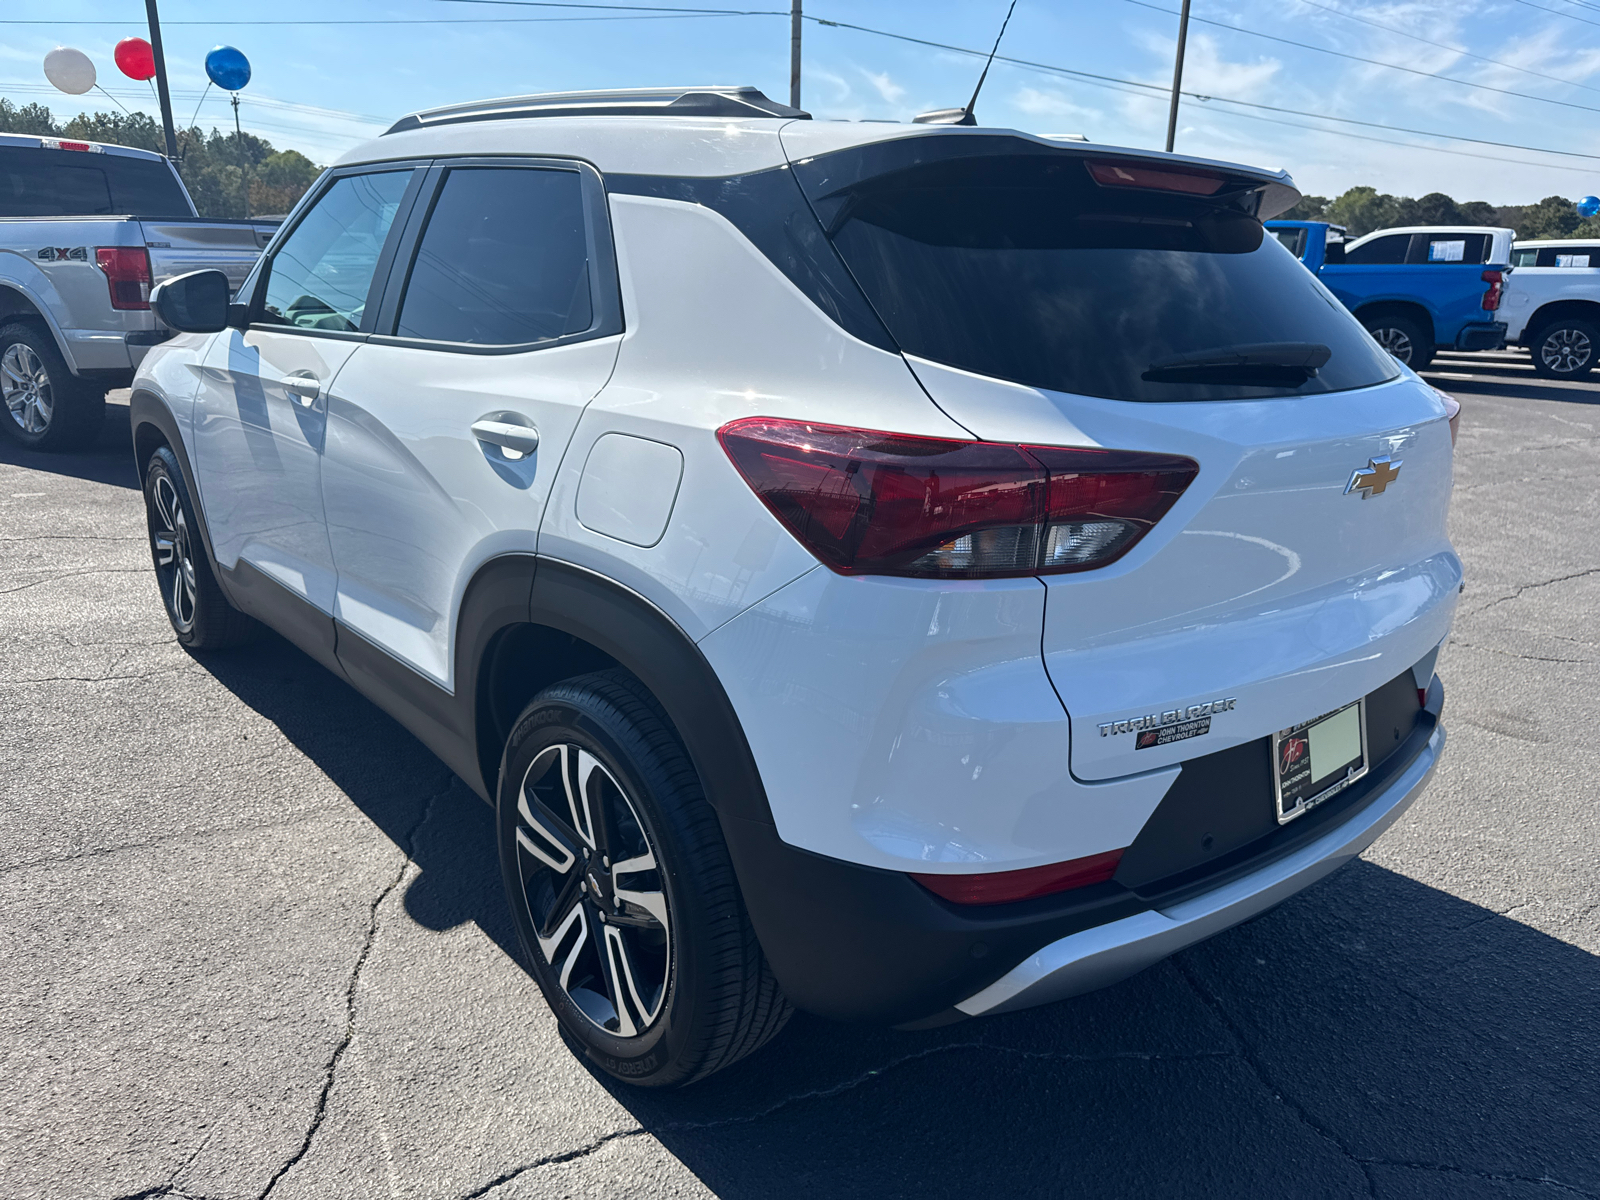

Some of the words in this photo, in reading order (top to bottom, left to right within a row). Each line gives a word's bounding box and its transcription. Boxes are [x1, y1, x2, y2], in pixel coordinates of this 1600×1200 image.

[1097, 697, 1237, 737] TRAILBLAZER
[1157, 730, 1197, 744] CHEVROLET
[1158, 727, 1176, 738] JOHN
[1177, 719, 1210, 733] THORNTON
